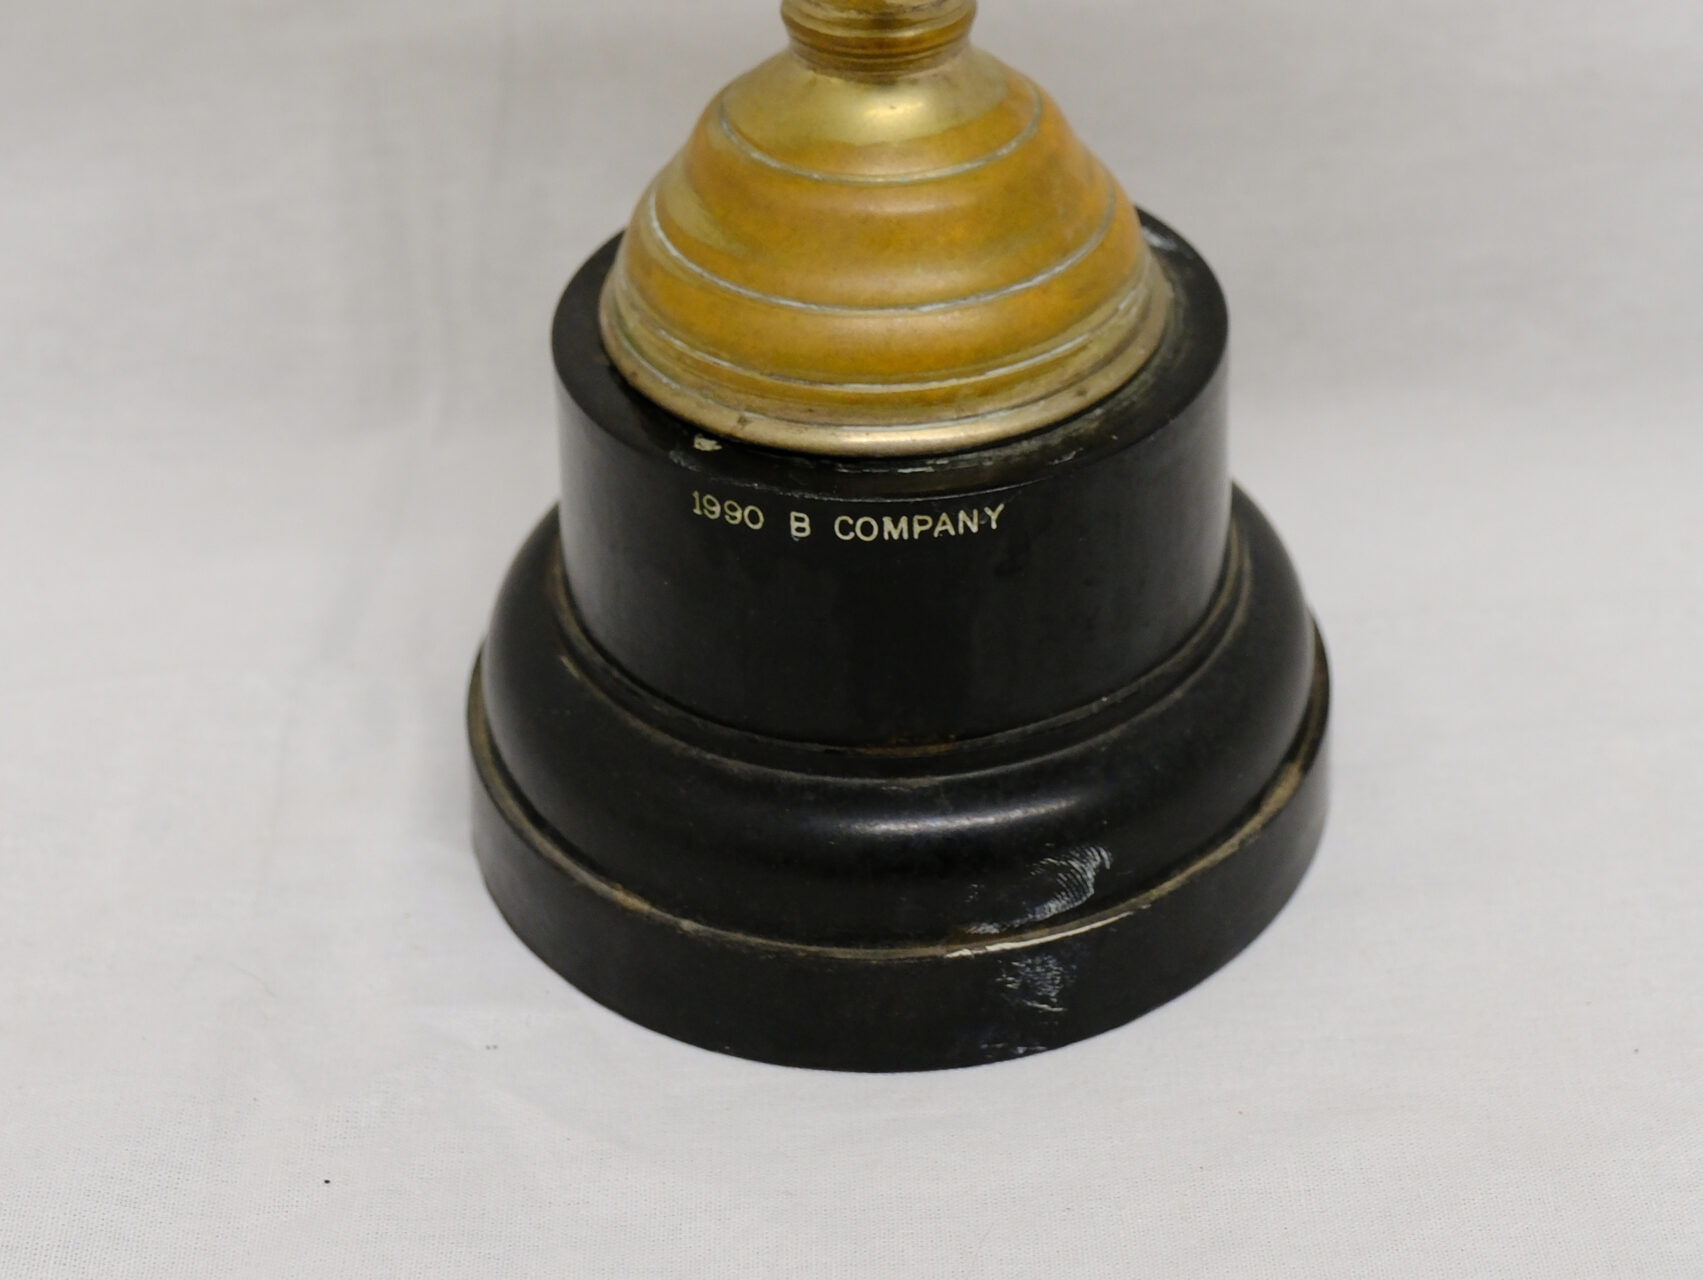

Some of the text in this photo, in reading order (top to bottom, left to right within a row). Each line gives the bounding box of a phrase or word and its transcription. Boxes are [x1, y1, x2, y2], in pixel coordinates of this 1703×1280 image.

[691, 489, 1006, 542] 1990 B COMPANY
